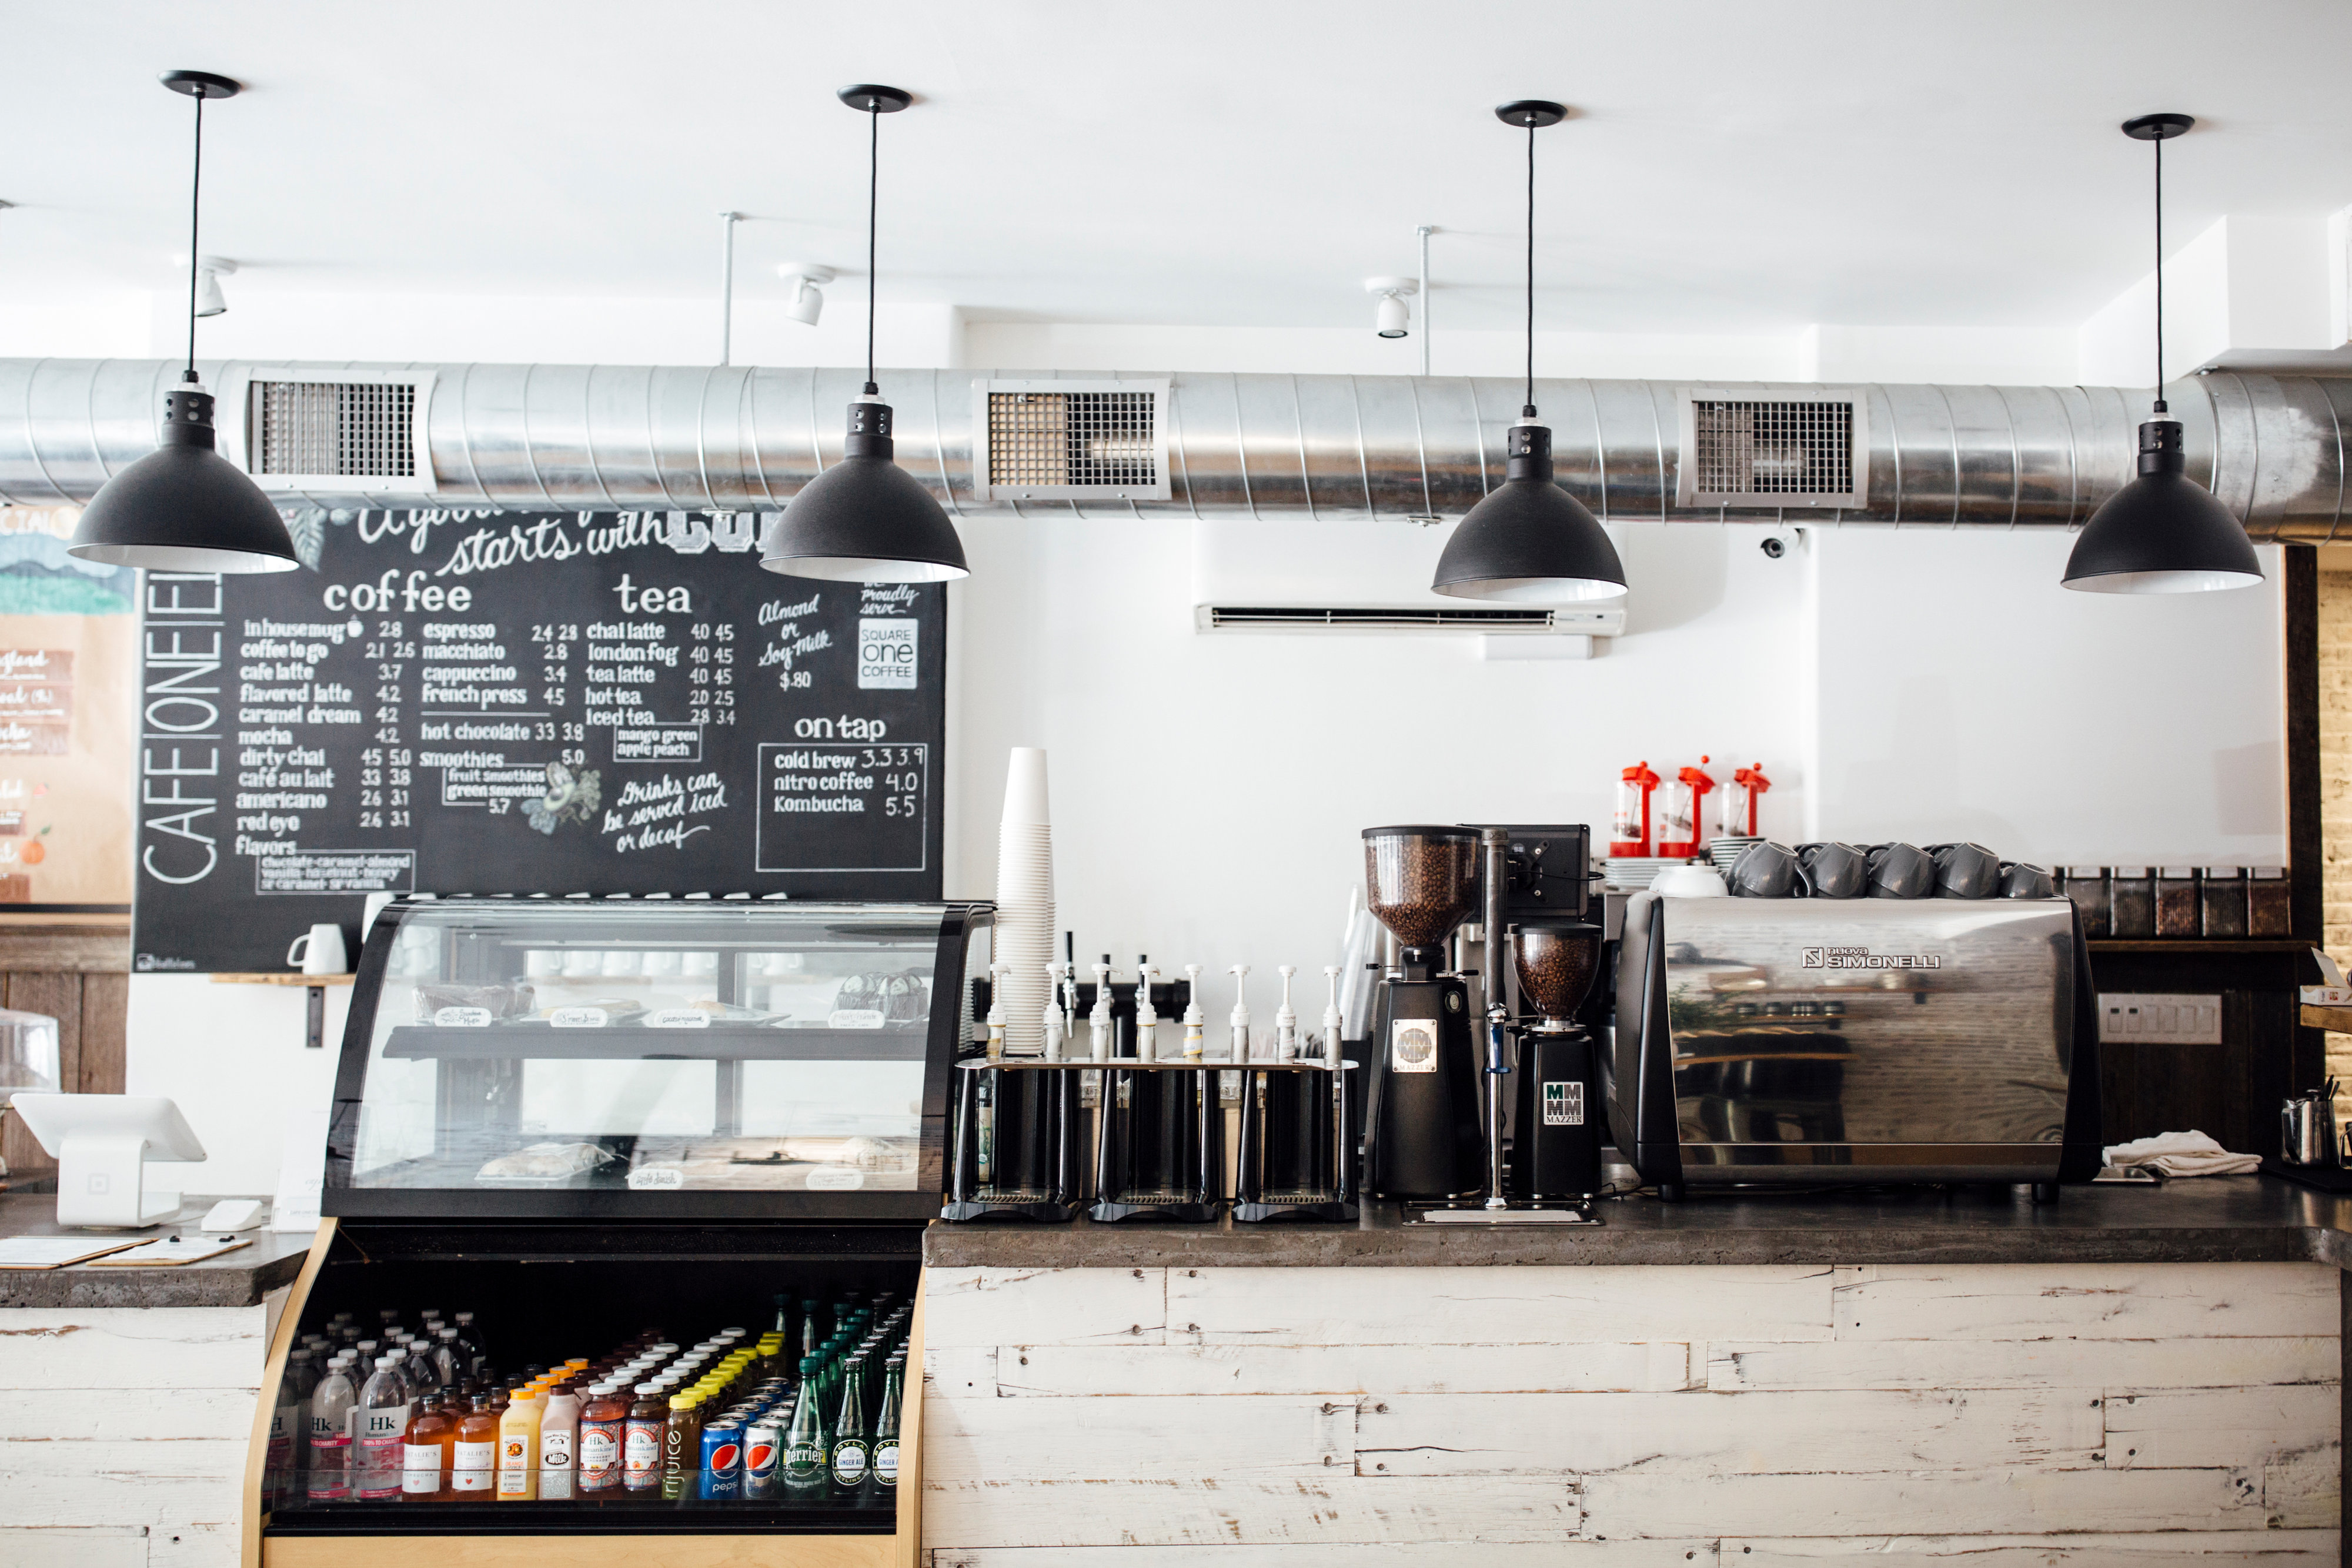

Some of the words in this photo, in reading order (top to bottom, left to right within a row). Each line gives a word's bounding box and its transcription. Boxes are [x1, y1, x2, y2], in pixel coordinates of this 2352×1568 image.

[435, 518, 582, 577] starts
[588, 511, 672, 555] with
[323, 569, 472, 612] coffee
[612, 573, 693, 614] tea
[861, 584, 920, 607] proudly
[758, 593, 820, 626] Almond
[859, 603, 907, 615] serve
[423, 623, 496, 643] espresso
[781, 622, 800, 640] or
[861, 629, 911, 642] SQUARE
[240, 638, 289, 658] coffee
[422, 642, 506, 660] macchiato
[758, 642, 793, 670] Soy
[791, 629, 833, 656] Milk
[863, 643, 914, 663] one
[422, 664, 517, 687] cappuccino
[861, 666, 911, 677] COFFEE
[145, 631, 222, 733] ONE
[240, 683, 310, 703] flavored
[313, 683, 352, 703] latte
[422, 683, 480, 703] french
[480, 688, 528, 711] press
[239, 704, 303, 724] caramel
[307, 703, 362, 724] dream
[626, 707, 656, 726] tea
[238, 725, 293, 745] mocha
[421, 721, 452, 740] hot
[454, 721, 530, 741] chocolate
[794, 717, 833, 738] on
[836, 714, 887, 743] tap
[239, 746, 286, 771] dirty
[419, 750, 505, 768] smoothies
[774, 750, 809, 769] cold
[812, 750, 857, 769] brew
[279, 771, 303, 788] au
[617, 773, 684, 807] Drinks
[687, 771, 722, 793] can
[774, 773, 818, 791] nitro
[819, 771, 874, 791] coffee
[236, 790, 328, 810] americano
[628, 794, 685, 826] served
[774, 794, 865, 813] Kombucha
[143, 747, 219, 884] CAFE
[236, 810, 268, 831] red
[269, 815, 301, 837] eye
[235, 834, 297, 855] flavors
[617, 833, 636, 853] or
[1827, 955, 1940, 968] SIMONELLI
[369, 1417, 396, 1430] Hk
[590, 1436, 604, 1445] Hk
[632, 1435, 646, 1444] Hk
[834, 1441, 868, 1456] BOYLAN
[874, 1441, 899, 1456] BOYL
[548, 1453, 567, 1464] Milk
[786, 1446, 823, 1469] perrier
[713, 1480, 739, 1493] pepsi
